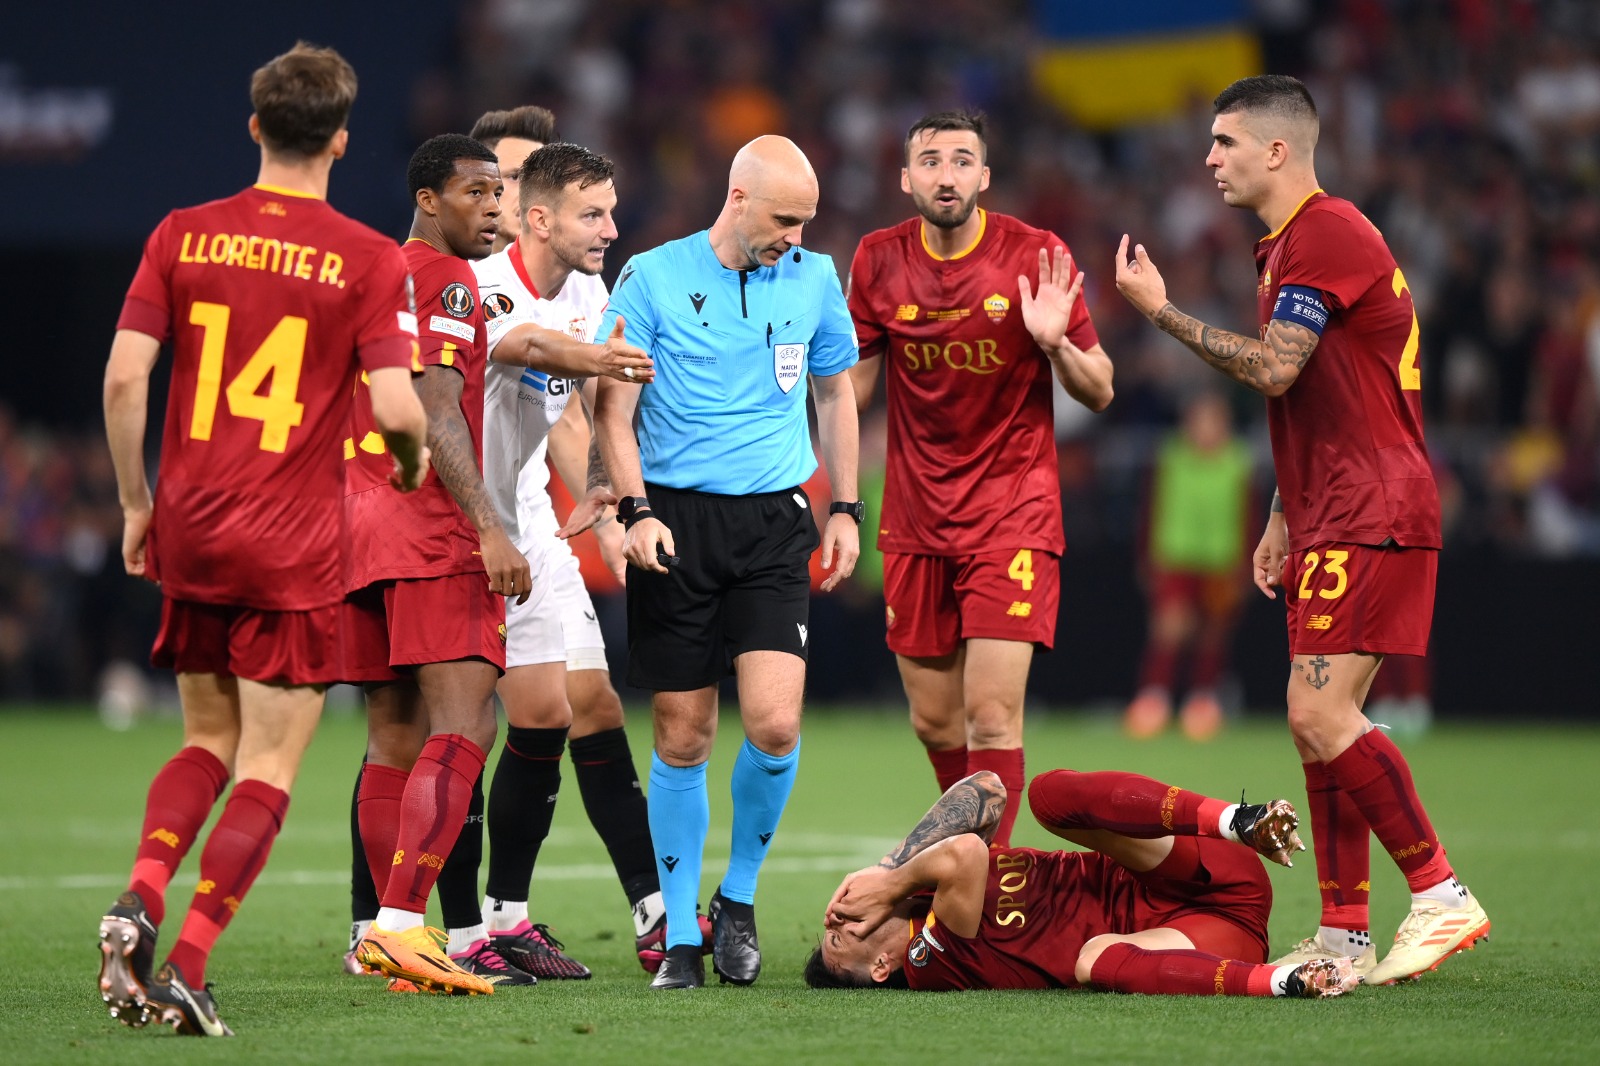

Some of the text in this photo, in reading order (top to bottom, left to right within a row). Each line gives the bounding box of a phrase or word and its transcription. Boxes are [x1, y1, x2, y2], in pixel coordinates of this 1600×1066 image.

[179, 232, 346, 289] LLORENTE R.
[1292, 292, 1304, 301] NO
[1304, 295, 1314, 305] TO
[189, 301, 308, 453] 14
[780, 350, 799, 359] UEFA
[904, 339, 1006, 375] SPQR
[1007, 549, 1034, 591] 4
[1298, 550, 1349, 600] 23
[996, 850, 1033, 928] SPQR
